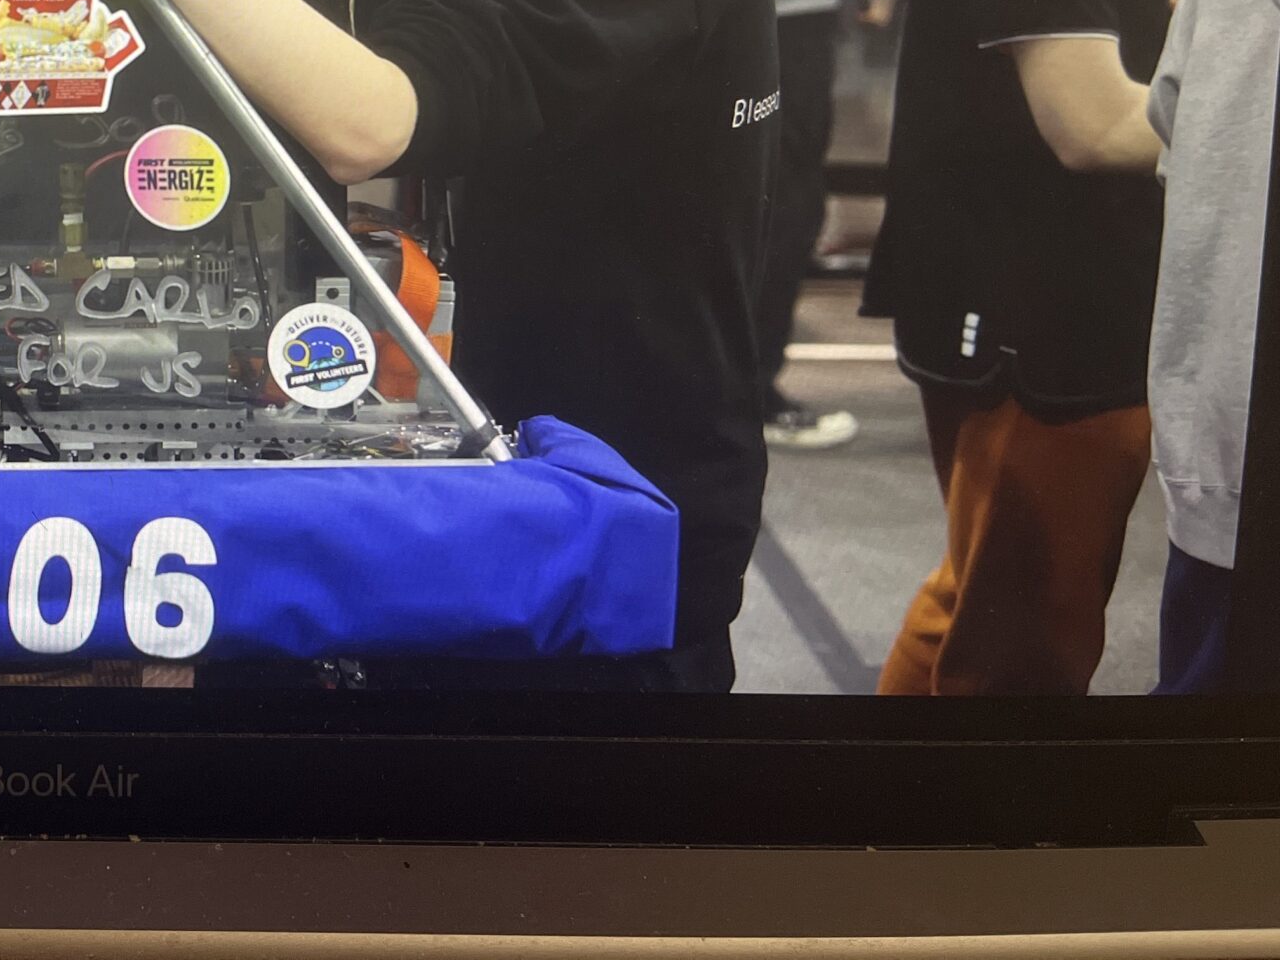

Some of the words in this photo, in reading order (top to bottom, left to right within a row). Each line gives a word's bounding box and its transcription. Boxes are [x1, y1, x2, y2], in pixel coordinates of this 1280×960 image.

[137, 159, 166, 167] FIRST
[137, 169, 215, 191] ENERGIZE
[76, 269, 260, 330] CARLO
[288, 315, 328, 334] DELIVER
[340, 321, 367, 355] FUTURE
[17, 334, 119, 388] FOR
[290, 373, 315, 386] FIRST
[315, 363, 364, 380] VOLUNTEERS
[86, 764, 140, 798] Air
